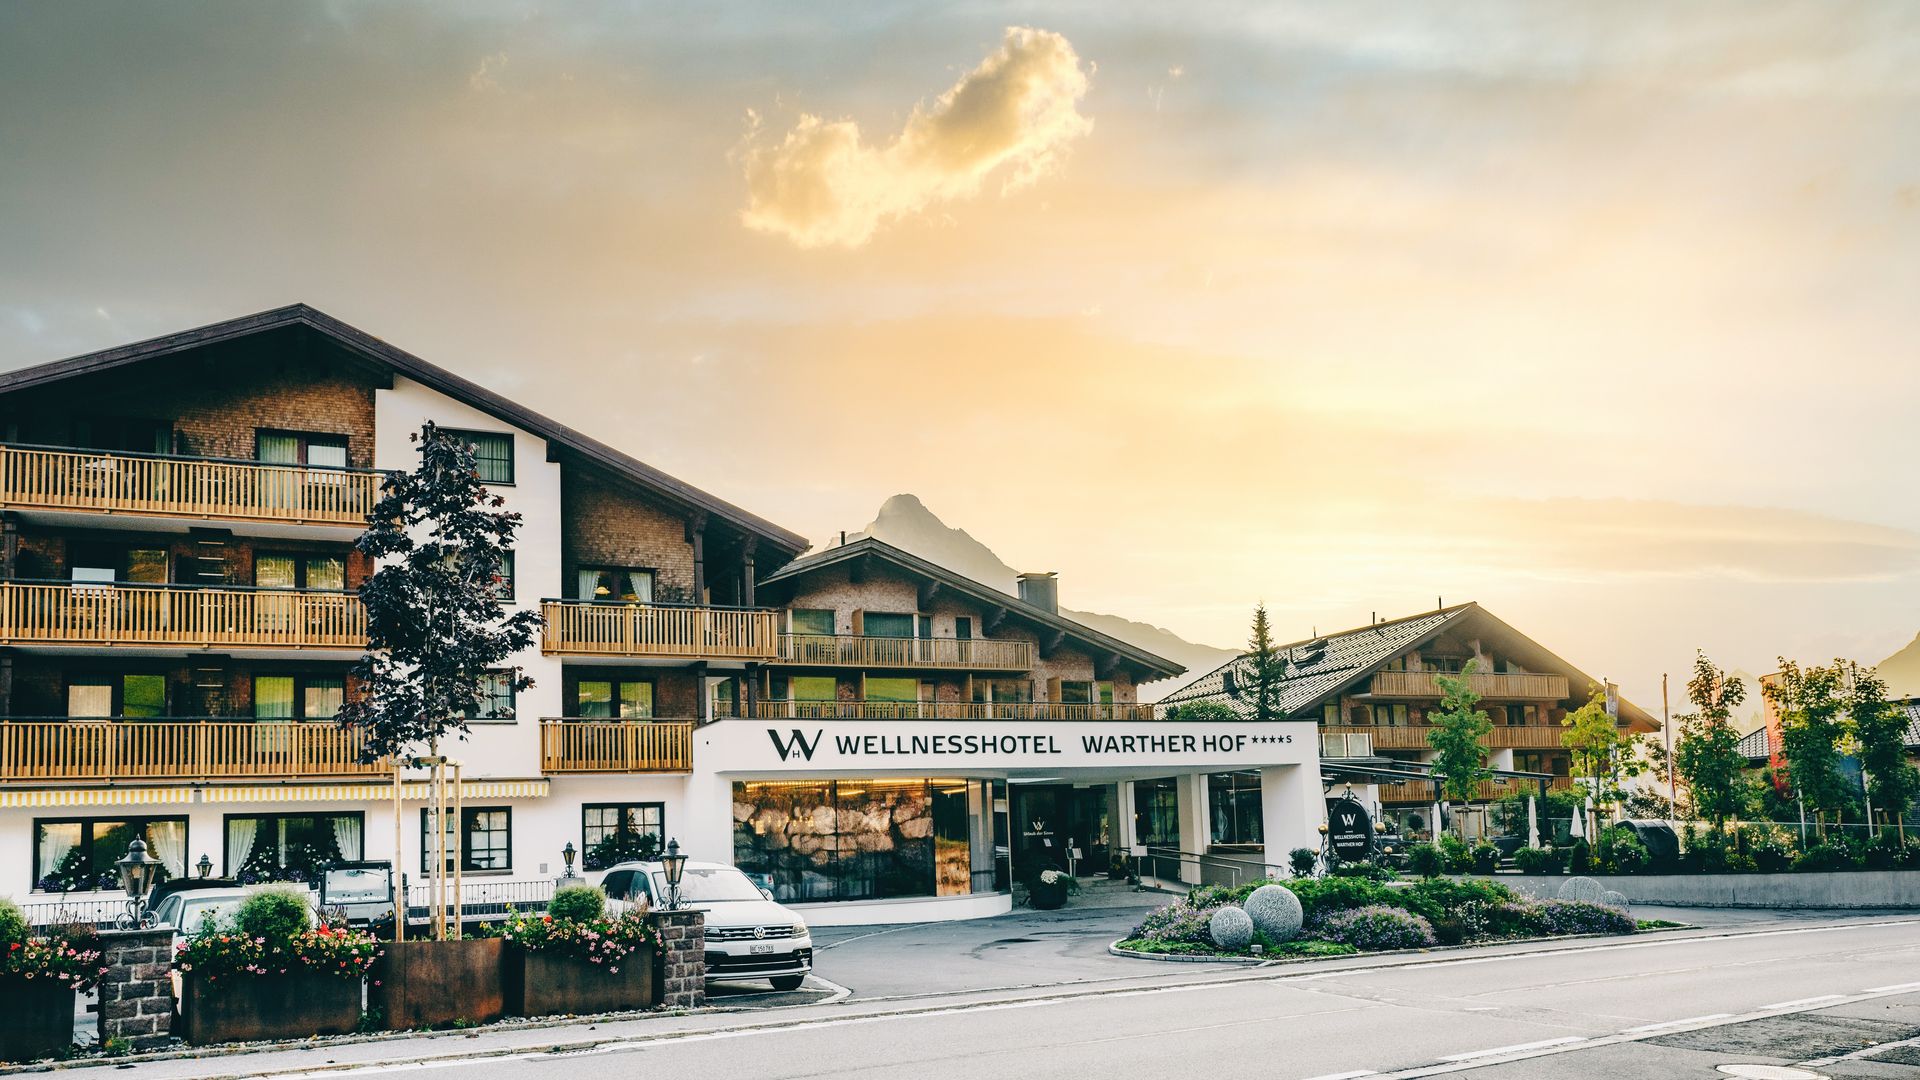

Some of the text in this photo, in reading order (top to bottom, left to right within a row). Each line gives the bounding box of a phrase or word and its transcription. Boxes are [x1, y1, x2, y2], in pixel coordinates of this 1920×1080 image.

[836, 736, 1061, 754] WELLNESSHOTEL
[1082, 735, 1196, 753] WARTHER
[1203, 735, 1246, 752] HOF
